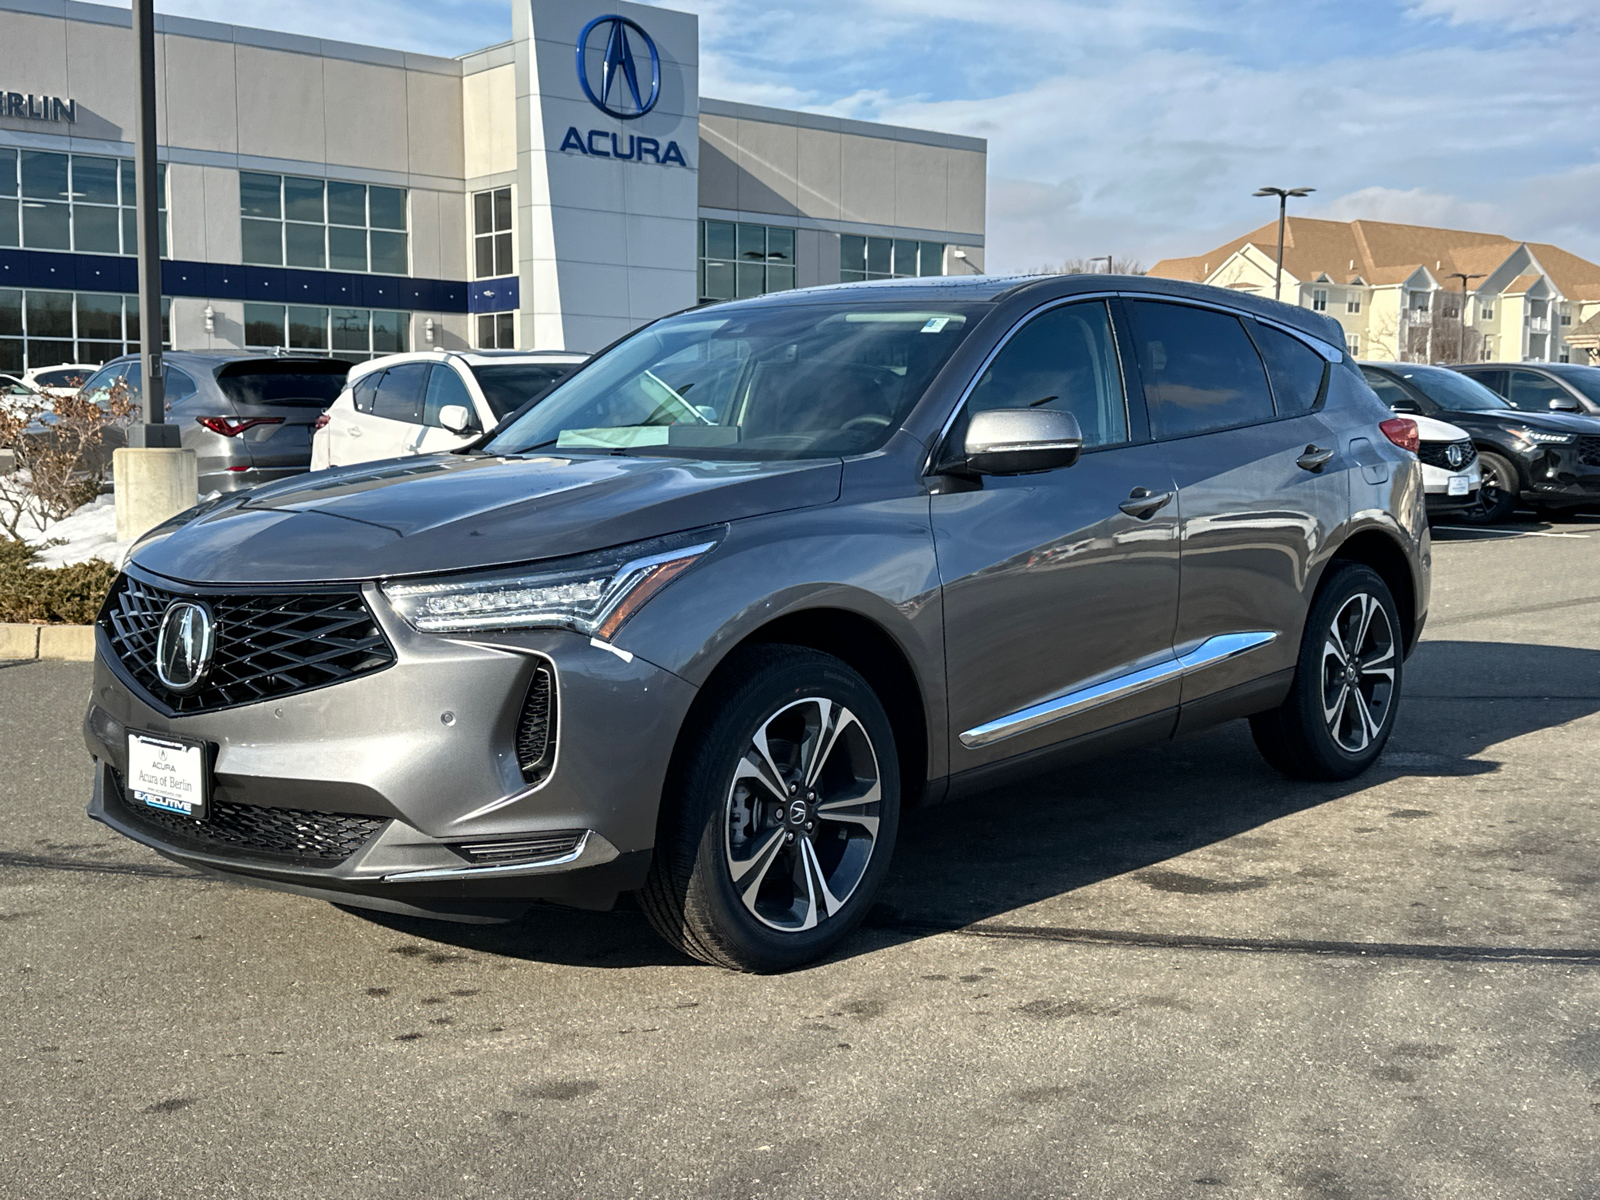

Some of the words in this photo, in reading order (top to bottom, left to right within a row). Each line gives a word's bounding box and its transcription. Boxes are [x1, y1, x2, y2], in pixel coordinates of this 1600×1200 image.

[559, 126, 687, 167] ACURA
[152, 761, 177, 773] ACURA
[138, 769, 158, 785] Acura
[159, 776, 168, 787] of
[169, 776, 192, 792] Berlin
